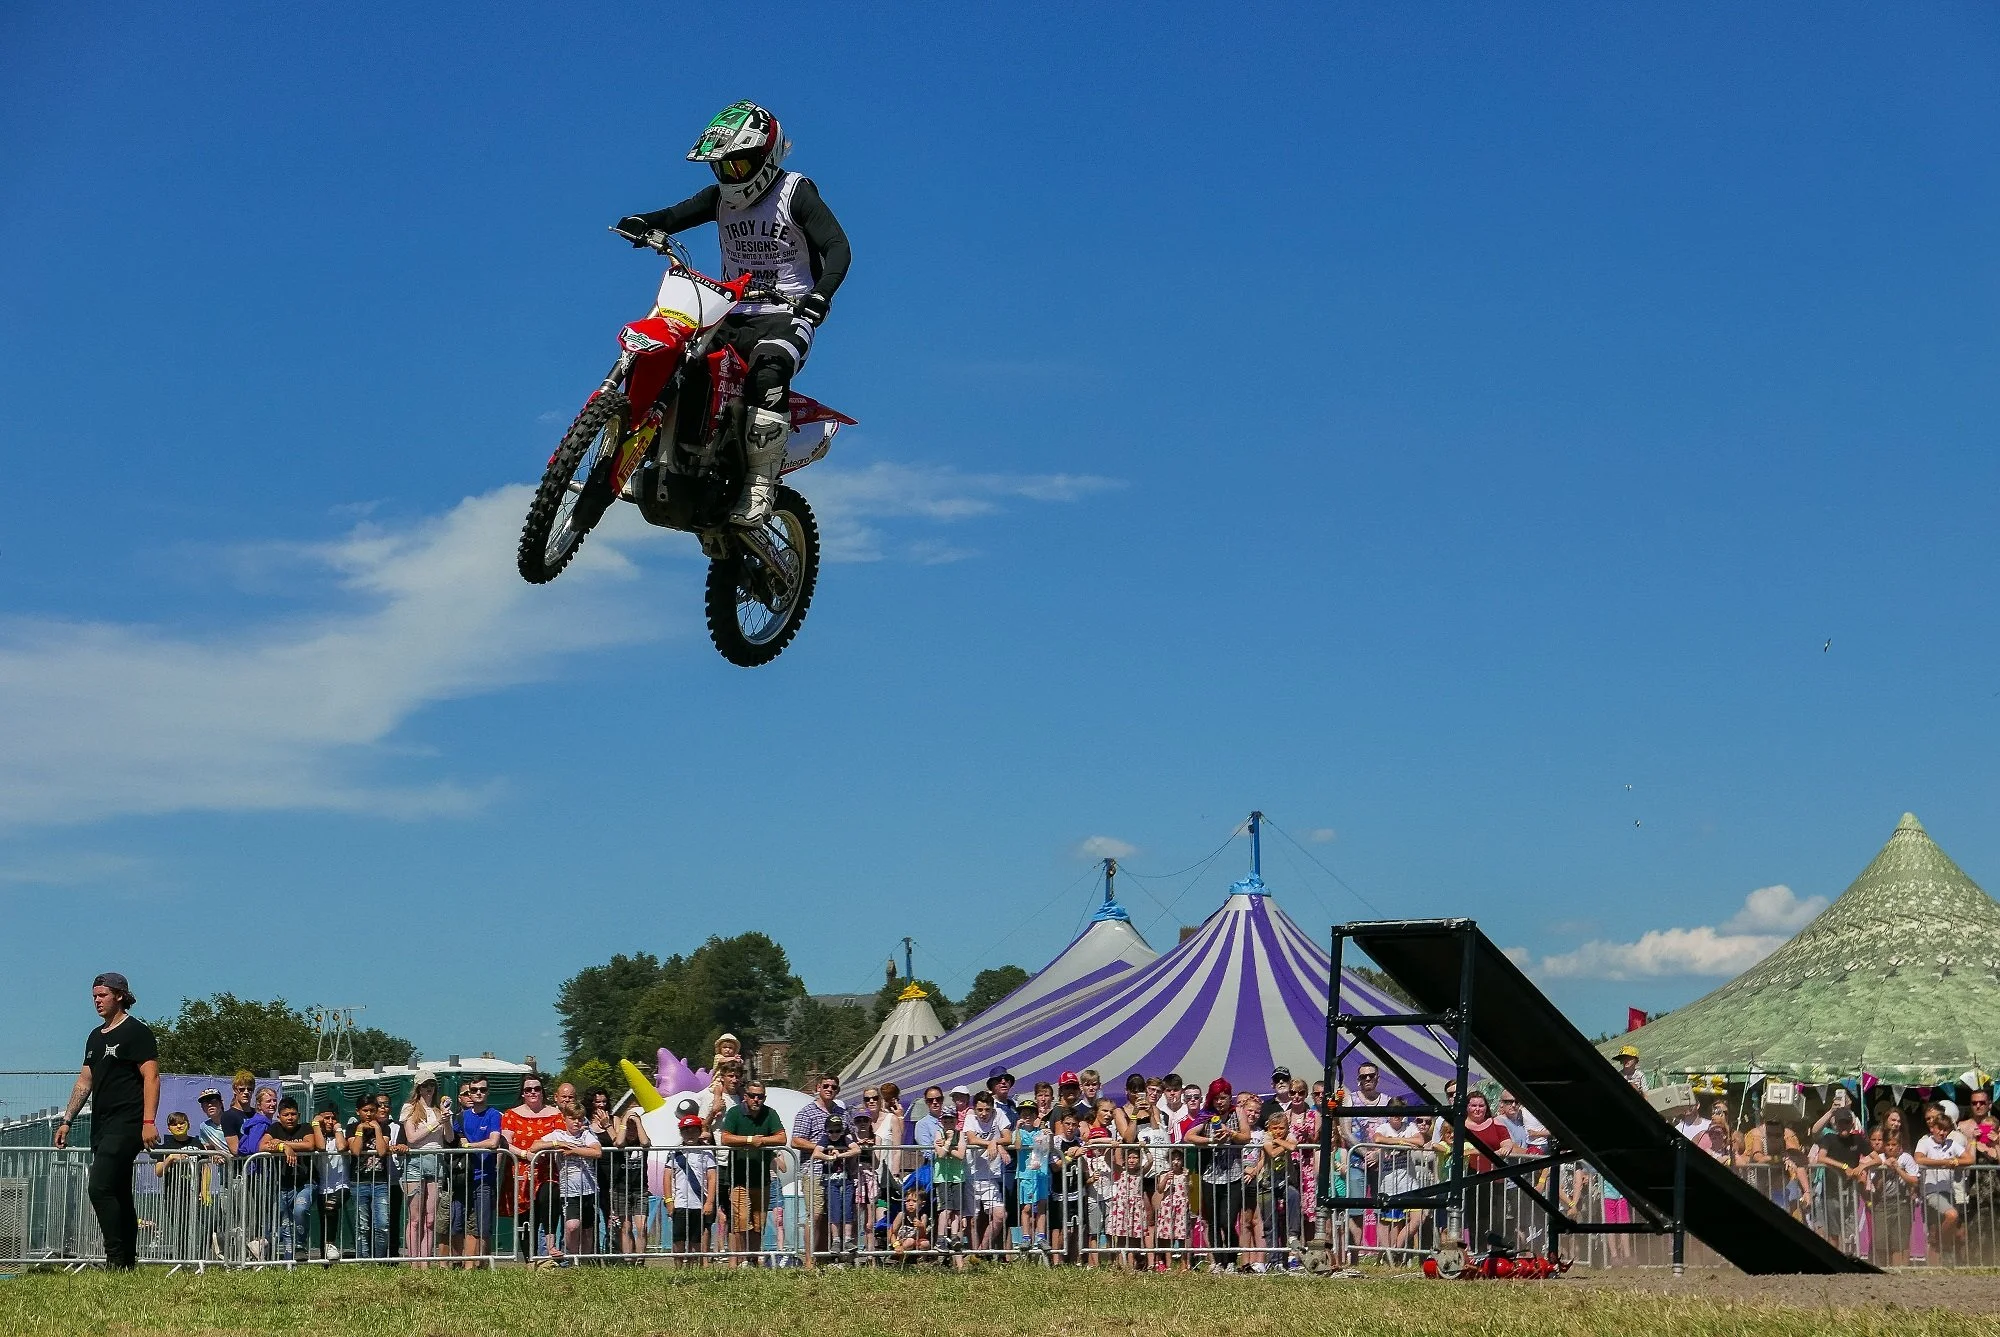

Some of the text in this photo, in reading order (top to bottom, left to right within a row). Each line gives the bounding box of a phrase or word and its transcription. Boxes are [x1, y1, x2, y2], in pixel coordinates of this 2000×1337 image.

[725, 220, 790, 240] TROY LEE
[735, 240, 779, 252] DESIGNS
[783, 249, 798, 258] SHOP
